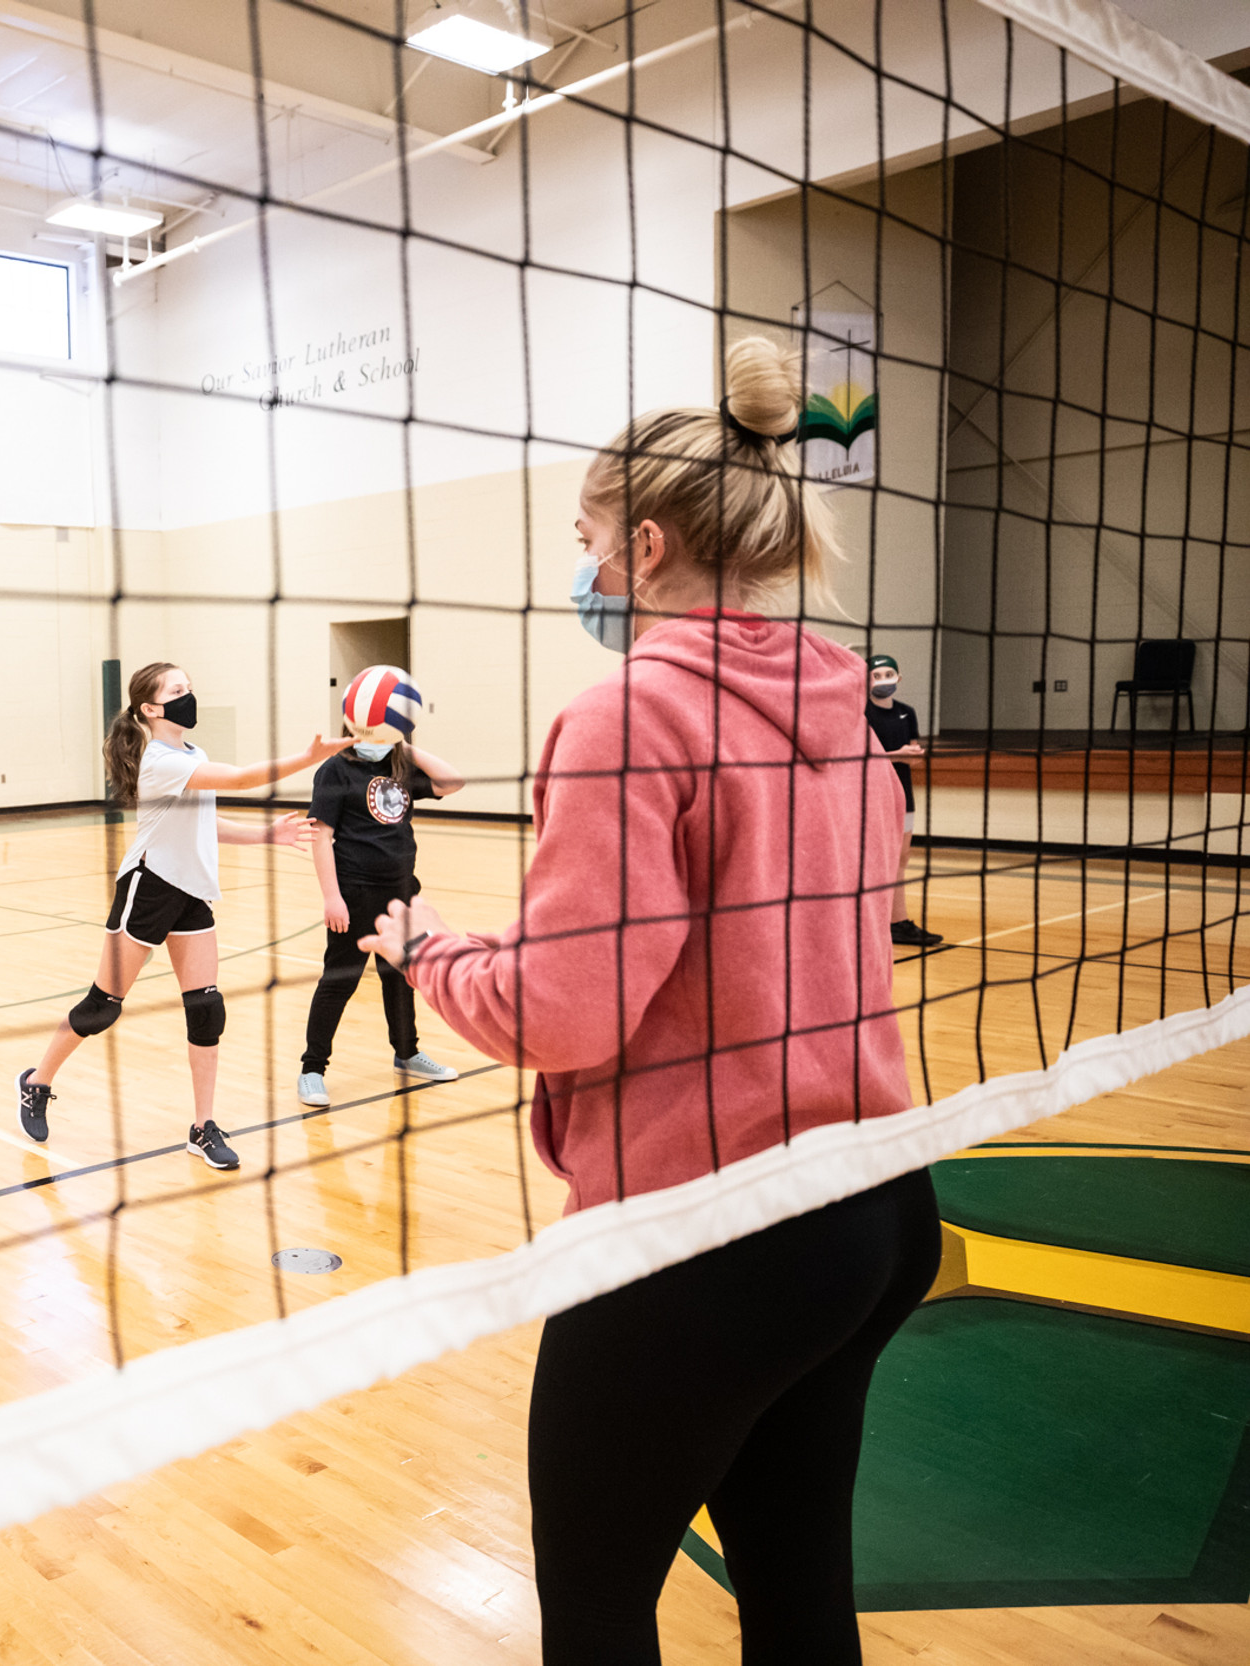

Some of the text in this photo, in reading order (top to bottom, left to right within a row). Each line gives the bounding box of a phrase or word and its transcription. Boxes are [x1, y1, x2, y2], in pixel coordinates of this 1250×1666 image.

[201, 326, 391, 395] Our Savior Lutheran
[259, 347, 421, 412] Church & School
[814, 462, 860, 480] LLELUIA
